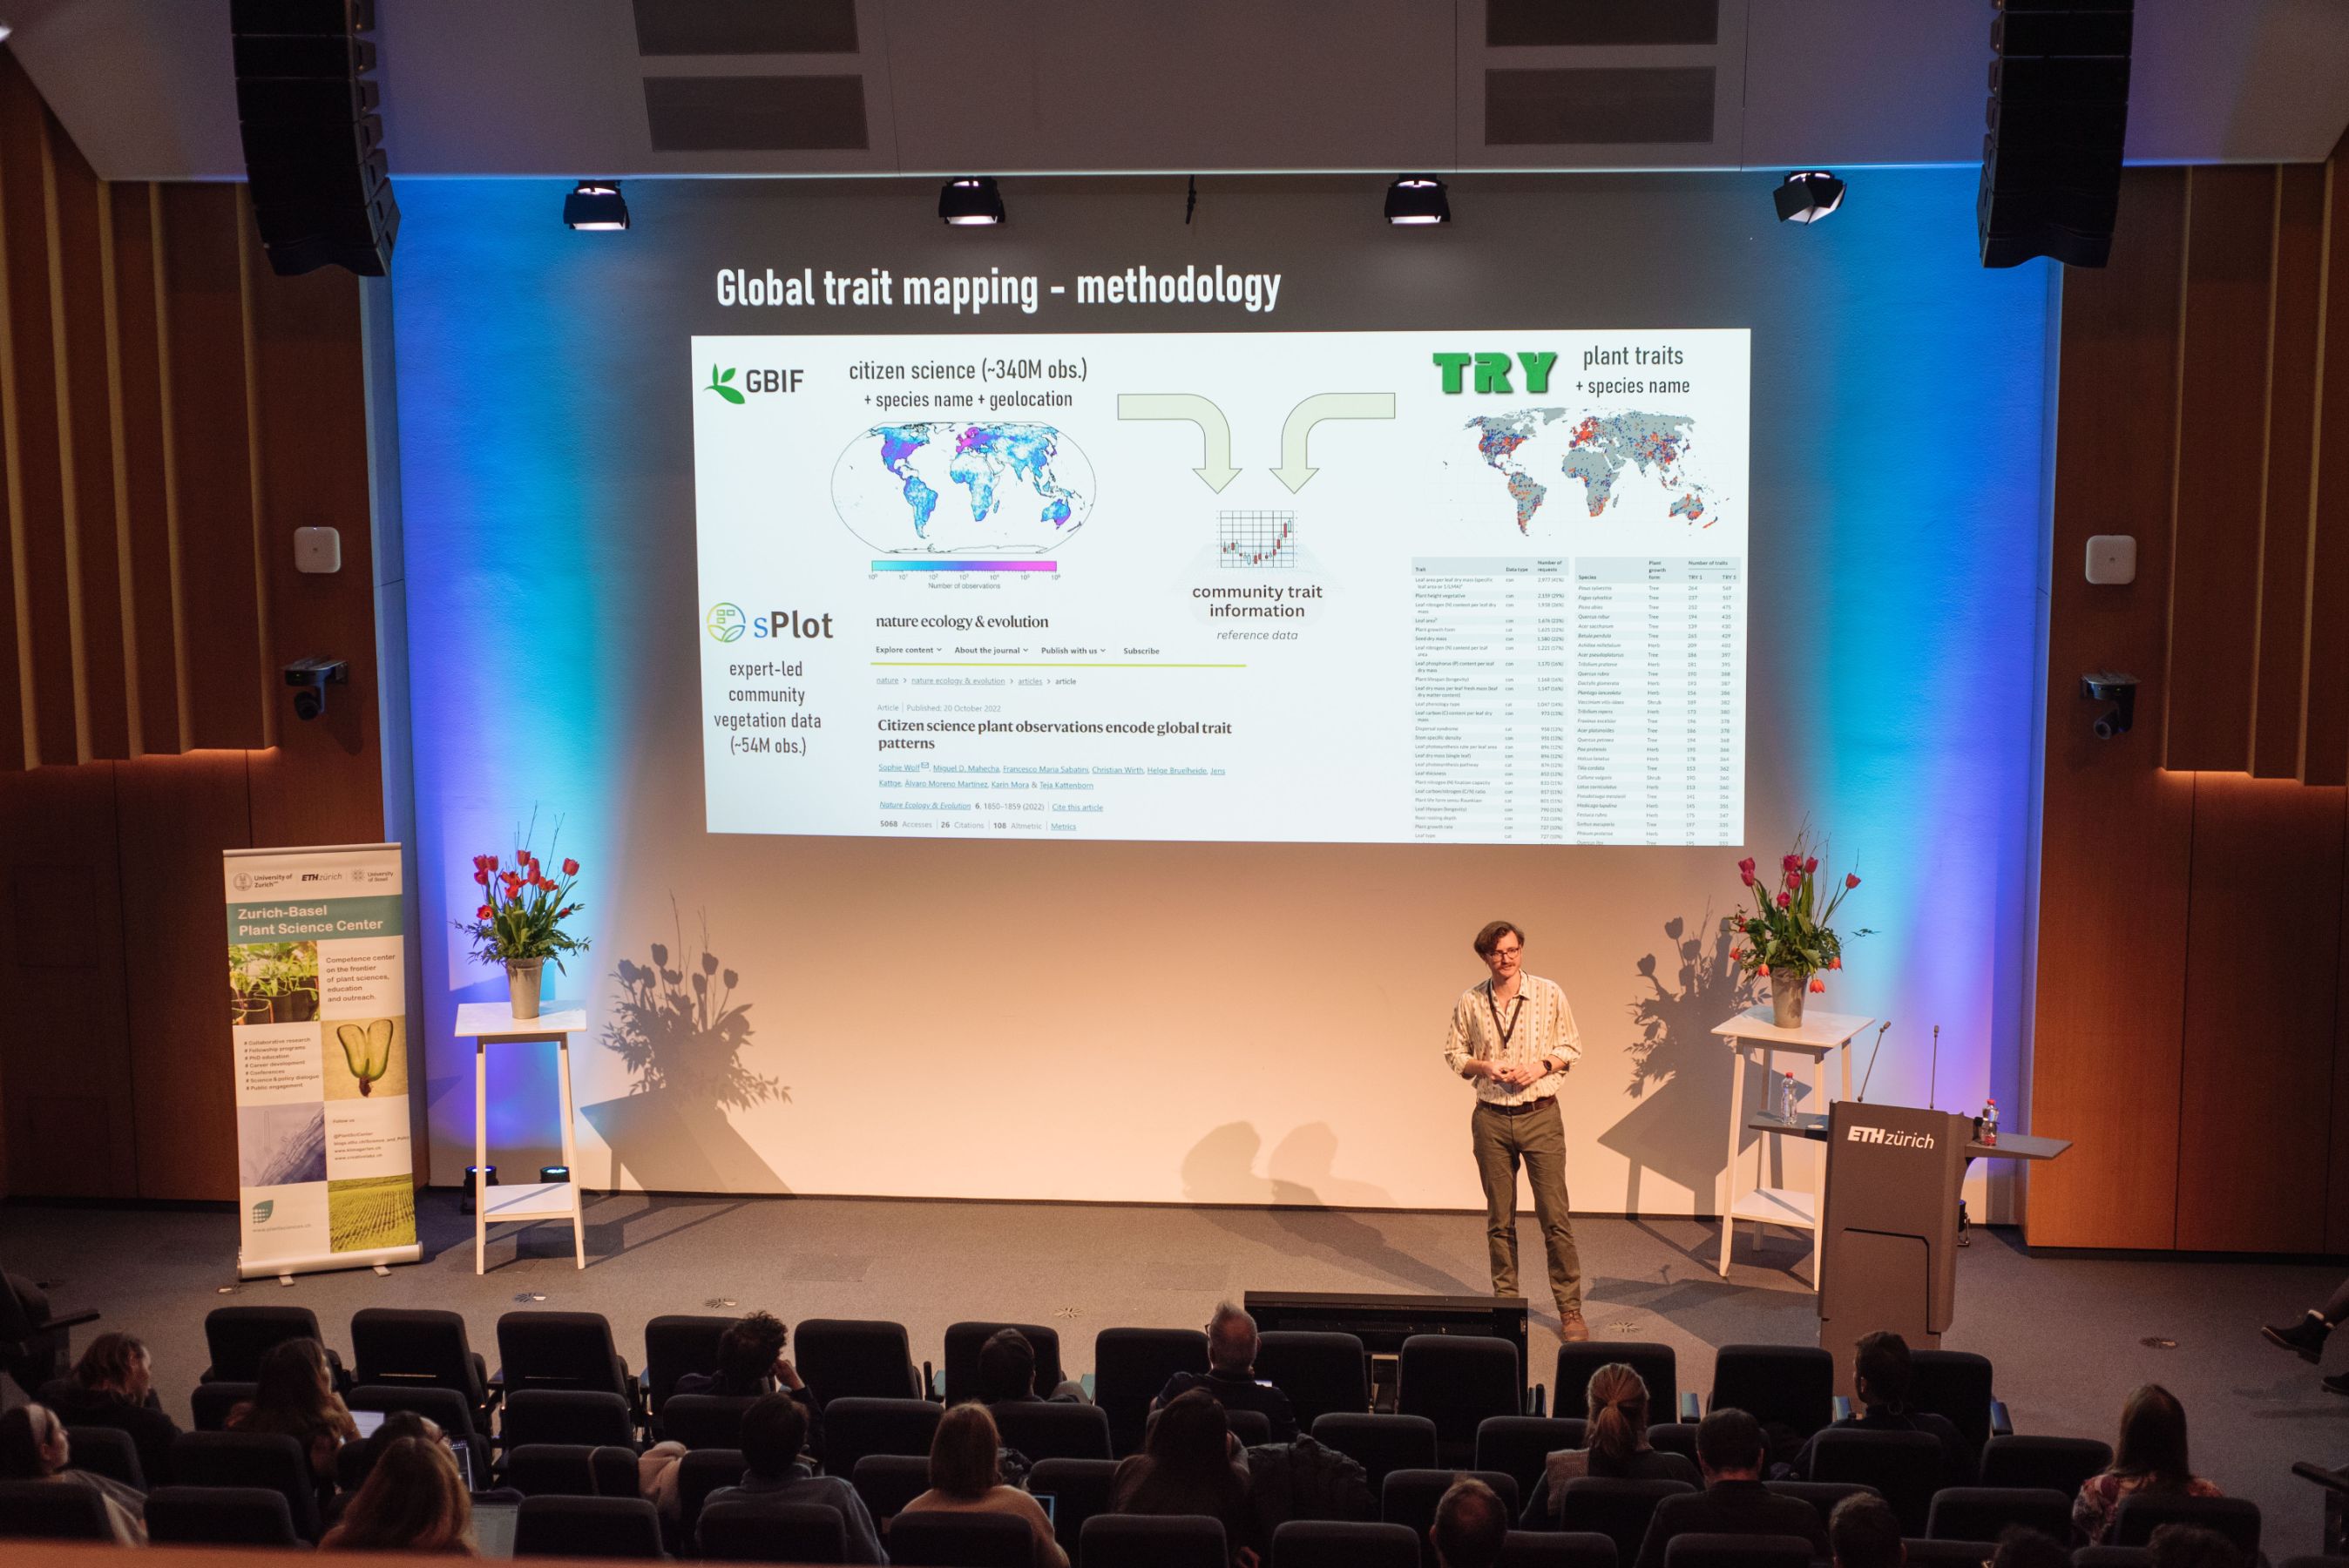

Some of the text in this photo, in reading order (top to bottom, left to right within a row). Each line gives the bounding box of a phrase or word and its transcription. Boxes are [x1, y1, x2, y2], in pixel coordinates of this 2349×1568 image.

[716, 267, 815, 306] Global
[823, 267, 892, 305] trait
[903, 267, 1038, 314] mapping
[1077, 265, 1282, 313] methodology
[1583, 345, 1683, 370] plant traits
[850, 356, 1086, 382] citizen science (~340M obs.)
[1432, 351, 1558, 394] TRY
[746, 368, 803, 393] GBIF
[1575, 376, 1689, 397] + species name
[864, 389, 1072, 411] + species name + geolocation
[1192, 585, 1323, 601] community trait
[1210, 603, 1304, 617] information
[754, 609, 833, 639] sPlot
[876, 614, 1048, 631] nature ecology & evolution
[1216, 629, 1298, 639] reference data
[876, 645, 903, 654] Explore
[993, 646, 1019, 655] journal
[729, 660, 802, 680] expert-led
[936, 678, 962, 686] ecology
[728, 686, 804, 706] community
[906, 704, 942, 713] Published:
[714, 712, 821, 731] vegetation data
[877, 719, 1231, 736] Citizen science plant observations encode global trait
[730, 735, 806, 756] (~54M obs.)
[878, 738, 935, 751] patterns
[878, 764, 904, 773] Sophie
[933, 765, 957, 774] Miguel
[905, 801, 930, 810] Ecology
[1052, 803, 1066, 812] Cite
[1067, 803, 1081, 812] this
[1051, 822, 1077, 831] Metrics
[237, 904, 328, 920] Zurich-Basel
[239, 919, 383, 936] Plant Science Center
